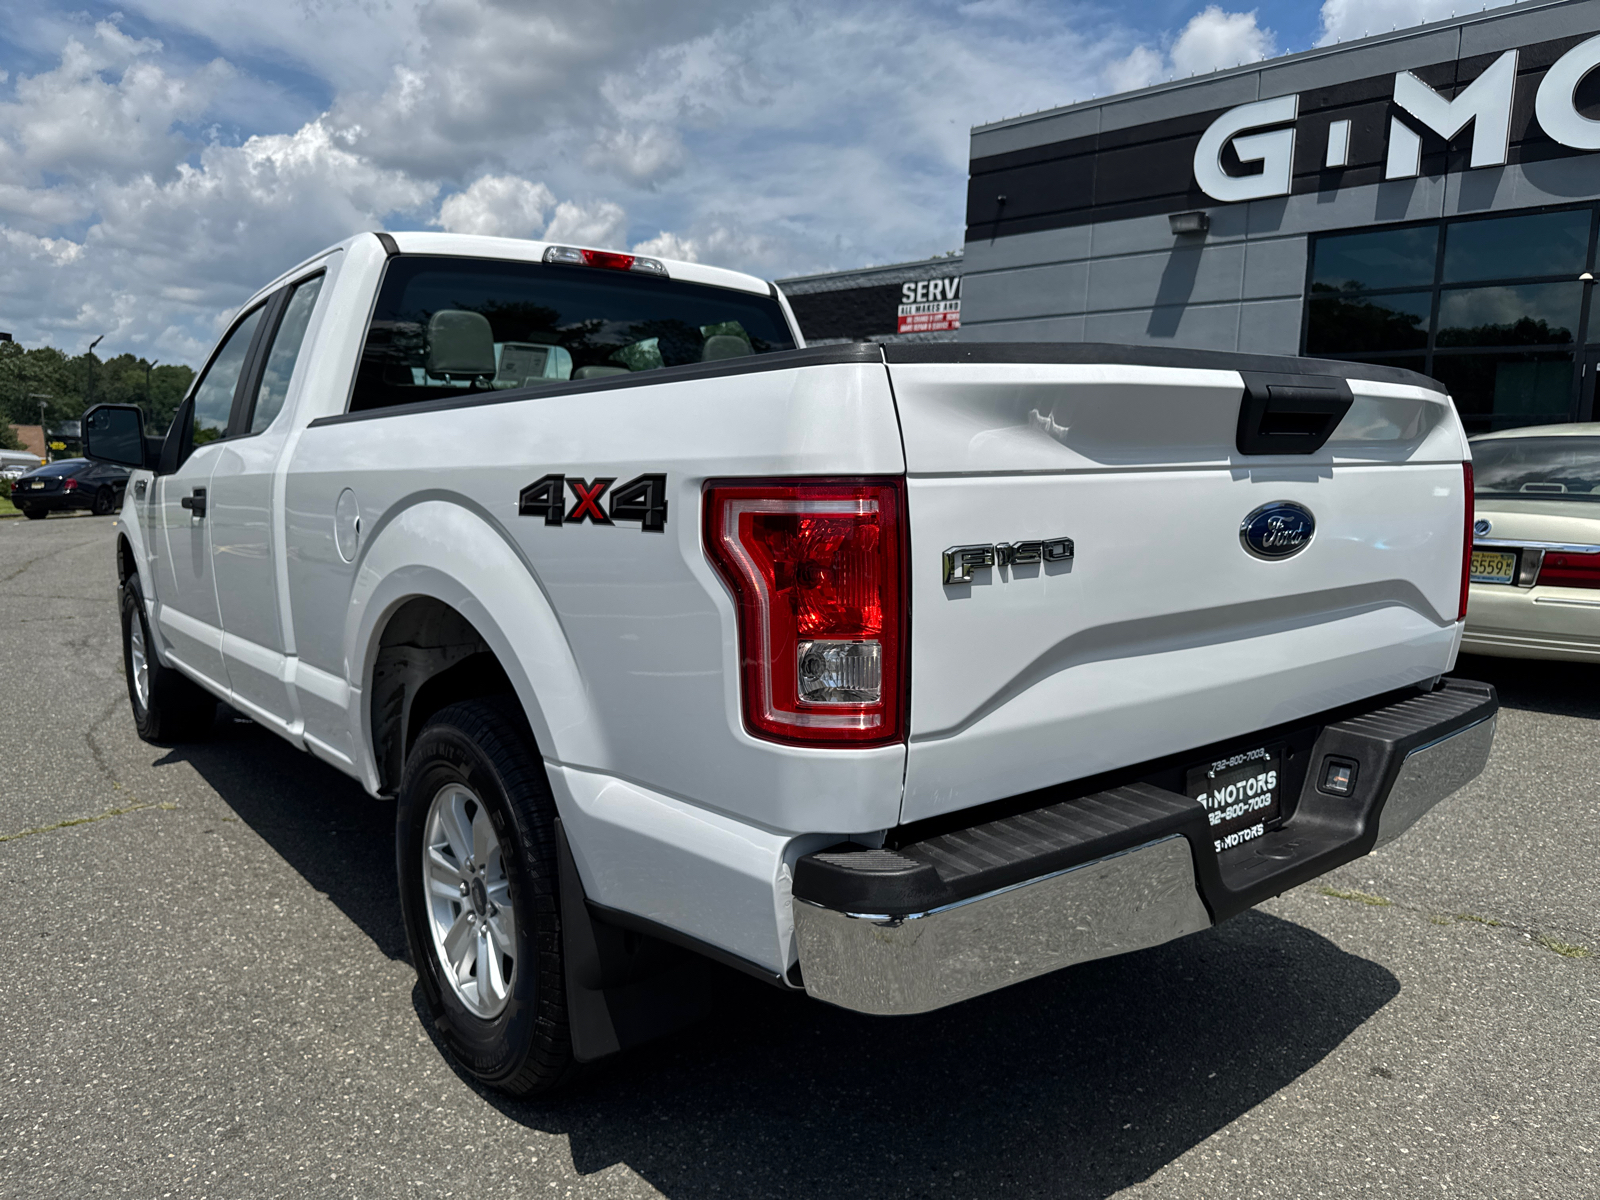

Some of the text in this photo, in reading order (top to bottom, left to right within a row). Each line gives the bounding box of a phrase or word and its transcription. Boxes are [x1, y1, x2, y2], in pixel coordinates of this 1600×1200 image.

[915, 303, 940, 313] MAKES
[518, 473, 668, 533] 4X4
[1262, 515, 1304, 548] Ford
[1211, 748, 1265, 772] 732-800-7003
[1208, 792, 1272, 826] 32-800-7003
